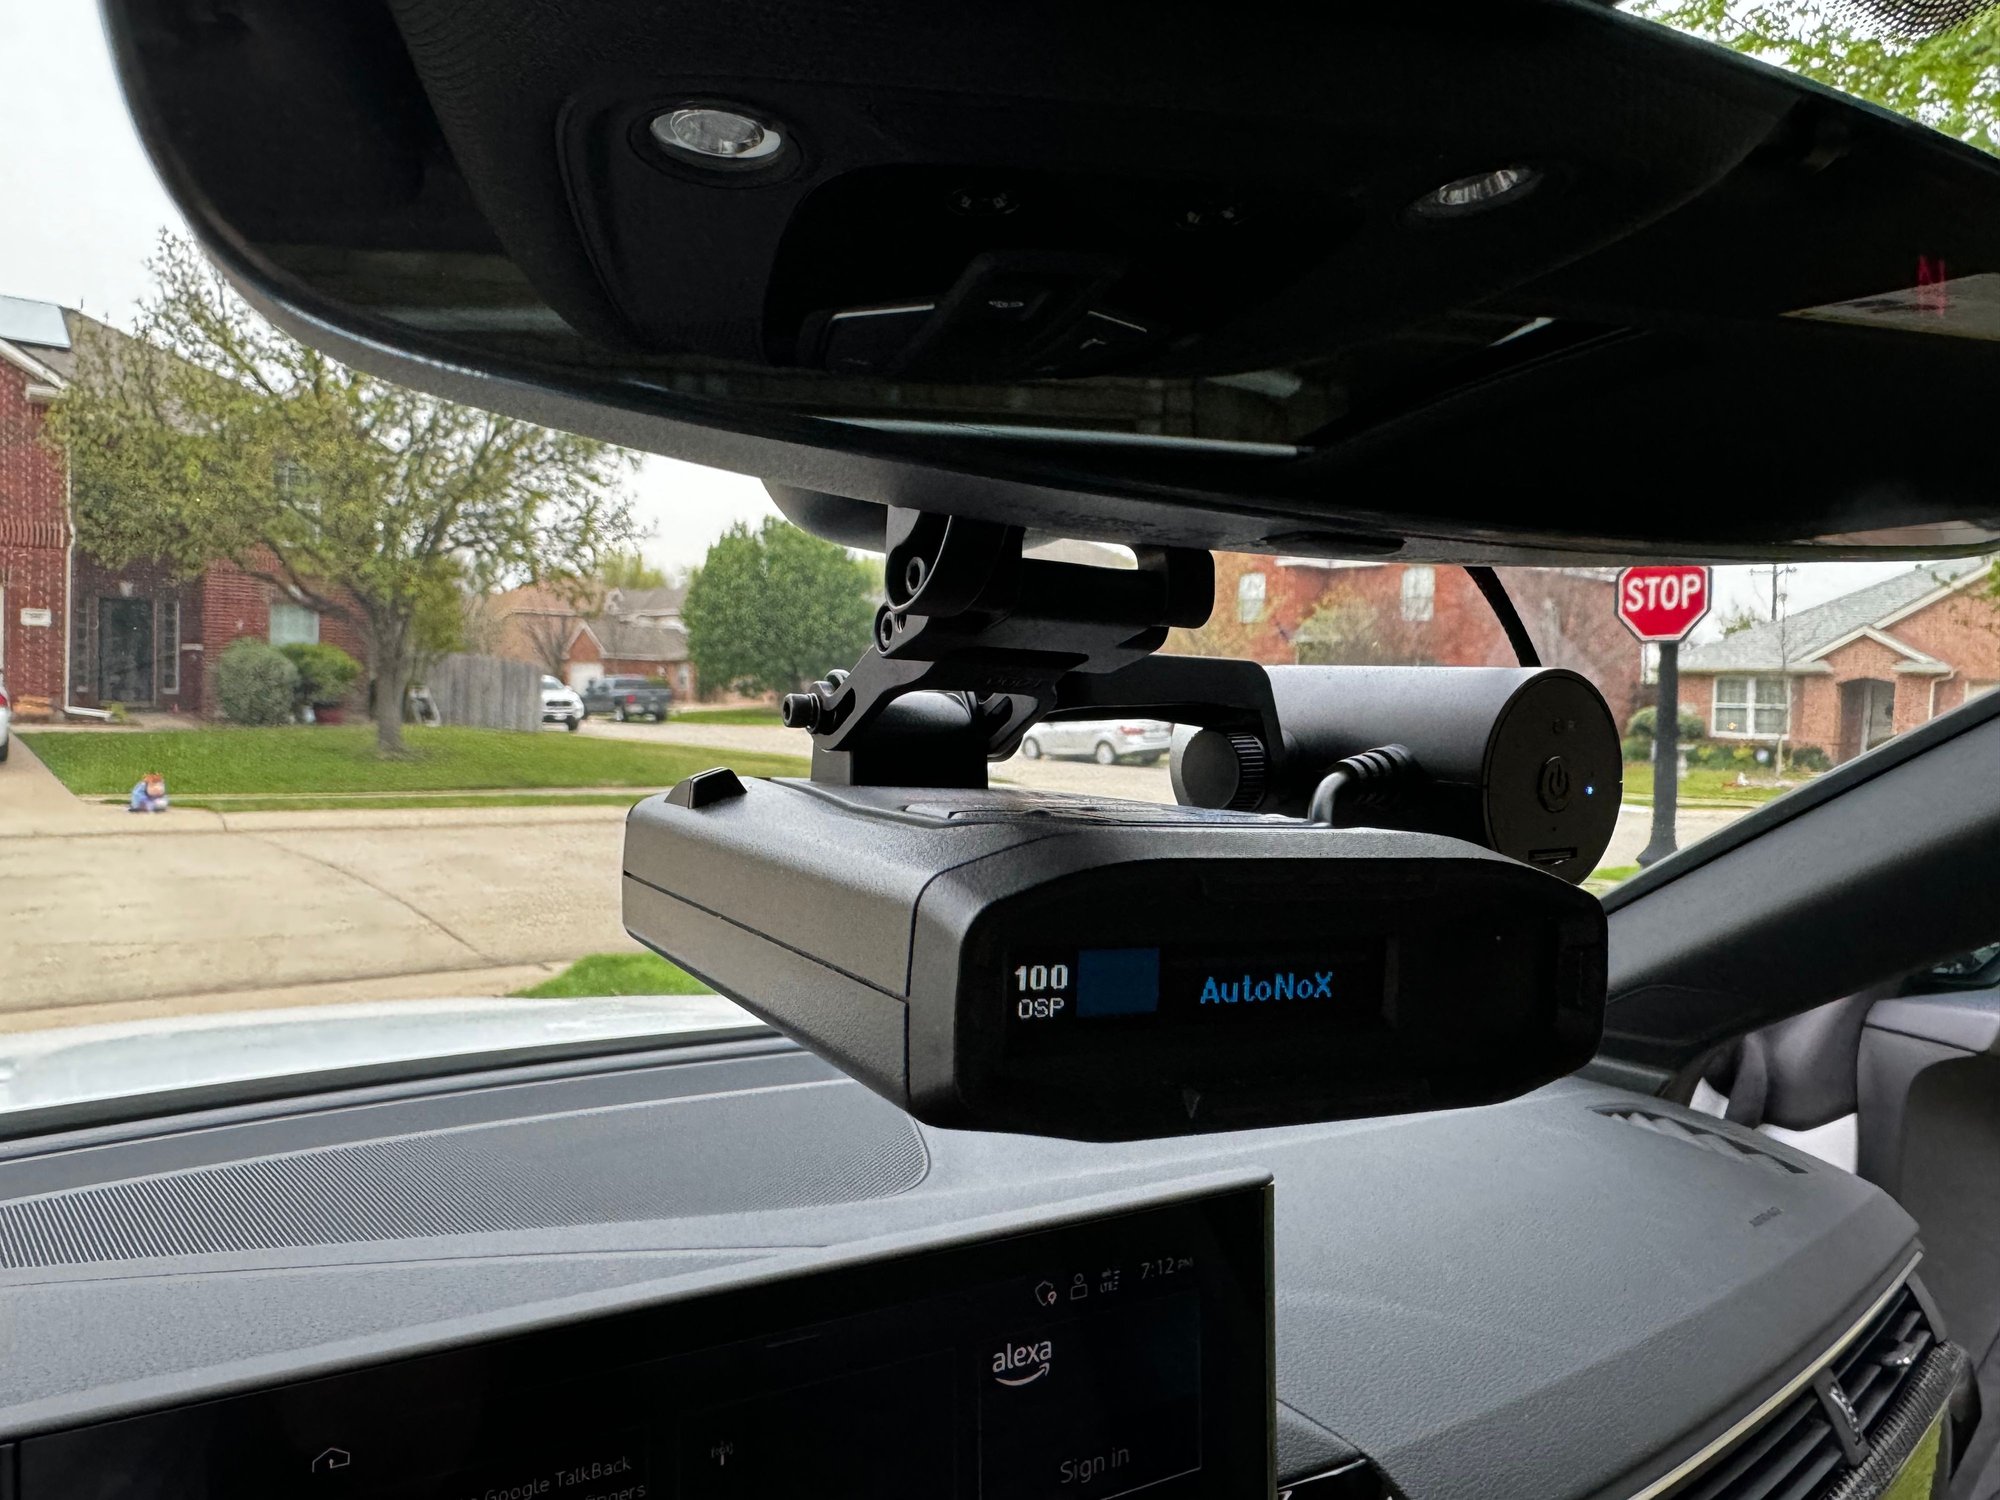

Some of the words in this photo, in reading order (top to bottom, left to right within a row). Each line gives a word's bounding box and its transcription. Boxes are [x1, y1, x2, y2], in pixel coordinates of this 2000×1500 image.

[1625, 573, 1701, 612] STOP
[1014, 964, 1068, 991] 100
[1199, 971, 1333, 1004] AutoNoX
[1018, 997, 1065, 1018] OSP
[1140, 1257, 1175, 1280] 7:12
[992, 1340, 1052, 1373] alexa
[484, 1478, 551, 1500] Google
[554, 1455, 632, 1488] TalkBack
[1060, 1455, 1105, 1484] Sign
[1111, 1447, 1130, 1468] in
